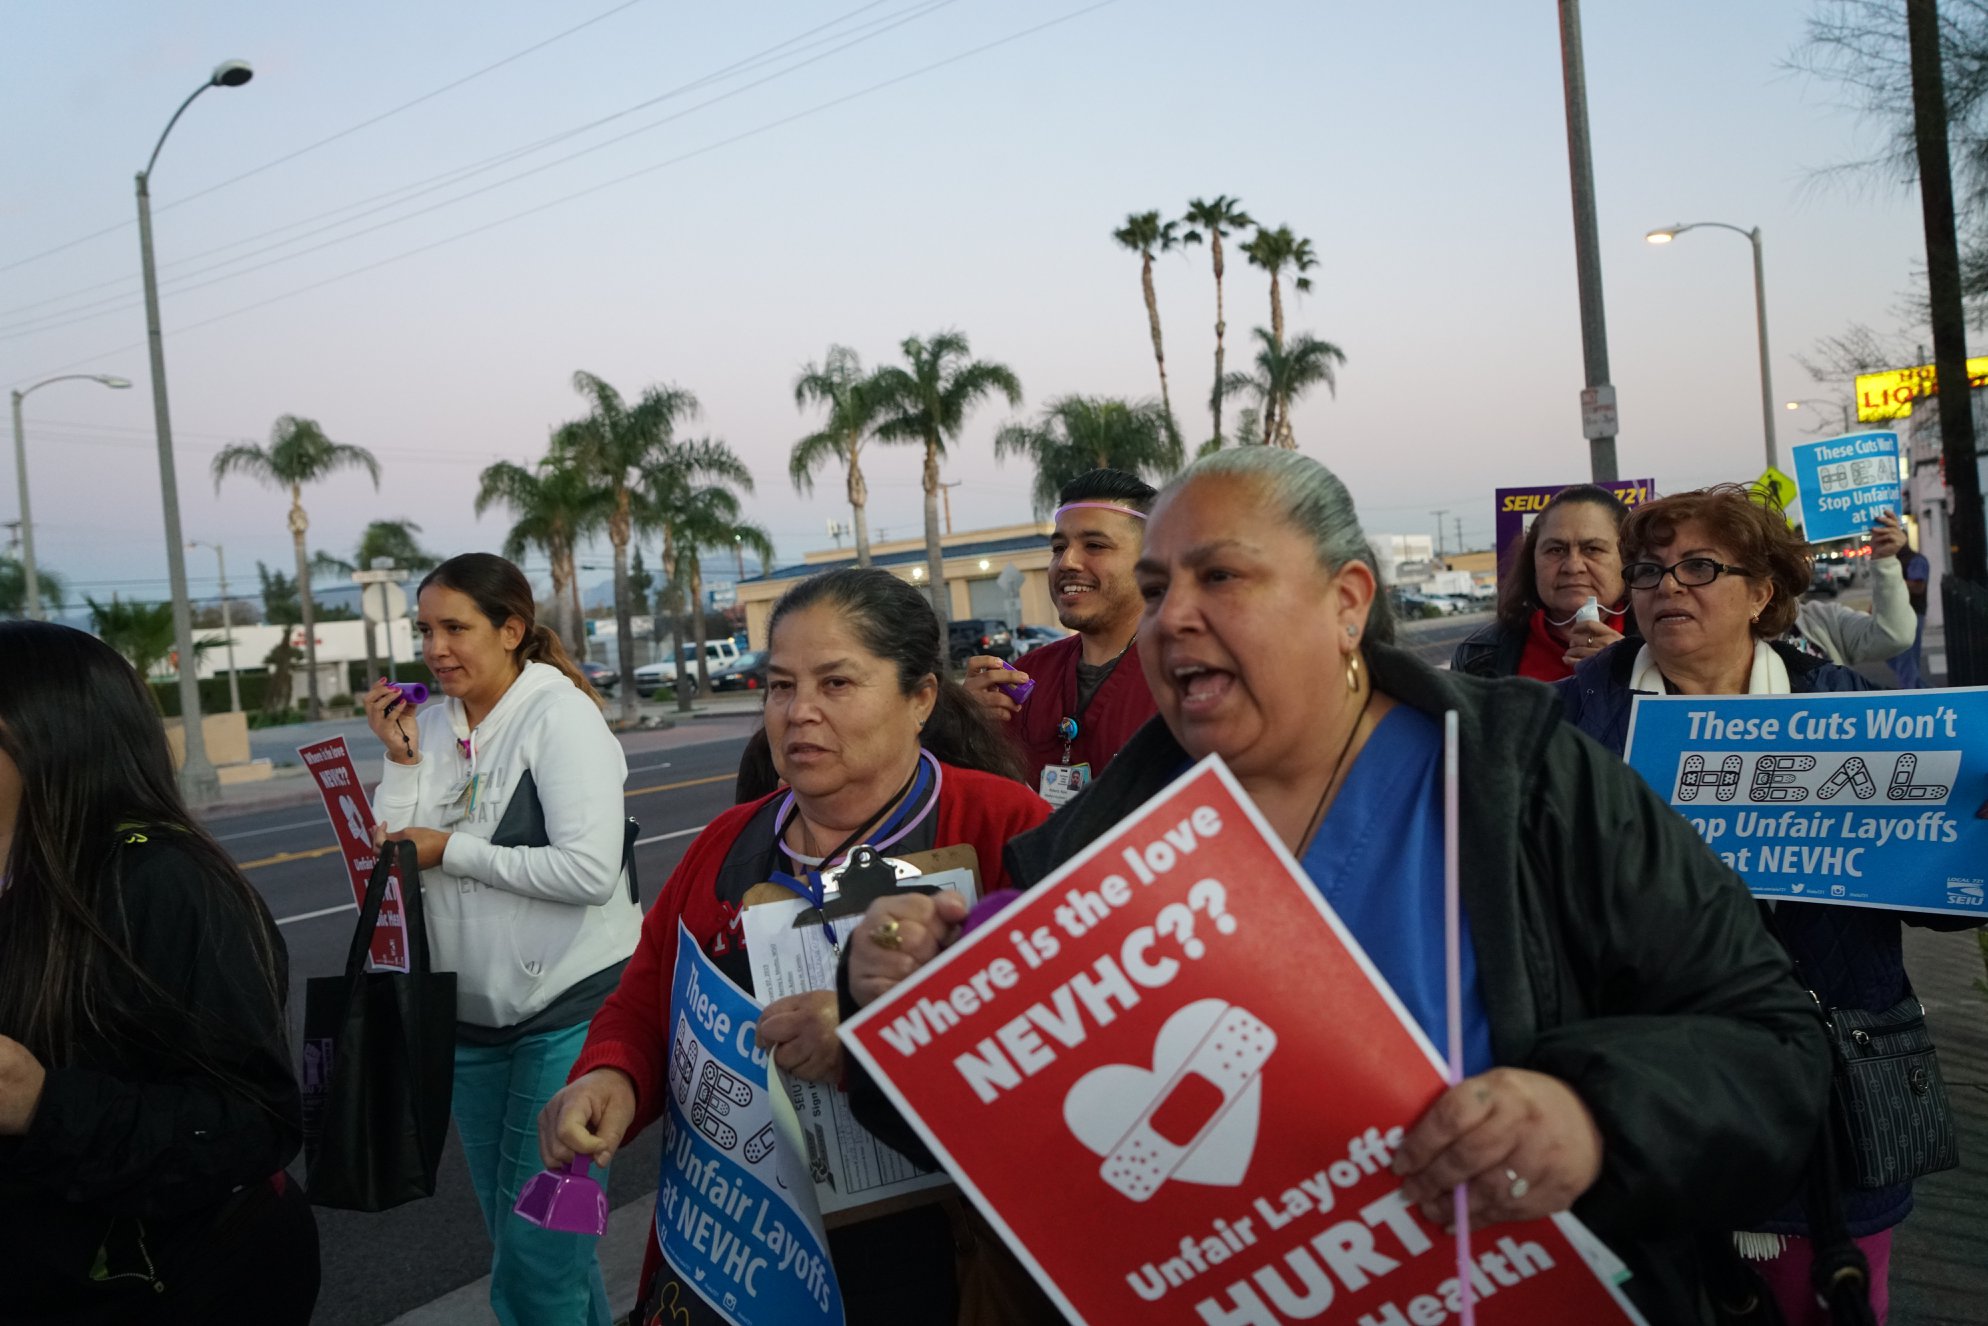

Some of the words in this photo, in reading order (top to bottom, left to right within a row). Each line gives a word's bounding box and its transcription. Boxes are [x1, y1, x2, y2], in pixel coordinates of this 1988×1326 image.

[1814, 446, 1854, 462] These
[1855, 440, 1877, 454] Cuts
[1502, 494, 1551, 512] SEIU
[1614, 487, 1647, 505] 721
[1818, 495, 1851, 512] Stop
[1852, 510, 1867, 524] at
[1687, 711, 1780, 741] These
[1788, 711, 1857, 741] Cuts
[1866, 706, 1958, 740] Won't
[1678, 752, 1949, 802] HEAL
[1683, 813, 1727, 845] op
[1735, 812, 1836, 838] Unfair
[1841, 812, 1958, 847] Layoffs
[1722, 848, 1751, 873] at
[1758, 846, 1865, 878] NEVHC
[1946, 895, 1985, 906] SEIU
[878, 958, 1019, 1057] Where
[1010, 927, 1060, 969] is
[1053, 874, 1133, 938] the
[1120, 805, 1223, 887] love
[953, 877, 1240, 1103] NEVHC??
[686, 961, 731, 1043] These
[736, 1020, 769, 1070] Cu
[791, 1084, 806, 1111] SEIU
[811, 1092, 822, 1118] Sign
[662, 1177, 678, 1220] at
[676, 1200, 767, 1297] NEVHC
[676, 1129, 752, 1221] Unfair
[750, 1198, 830, 1314] Layoffs
[1125, 1216, 1258, 1301] Unfair
